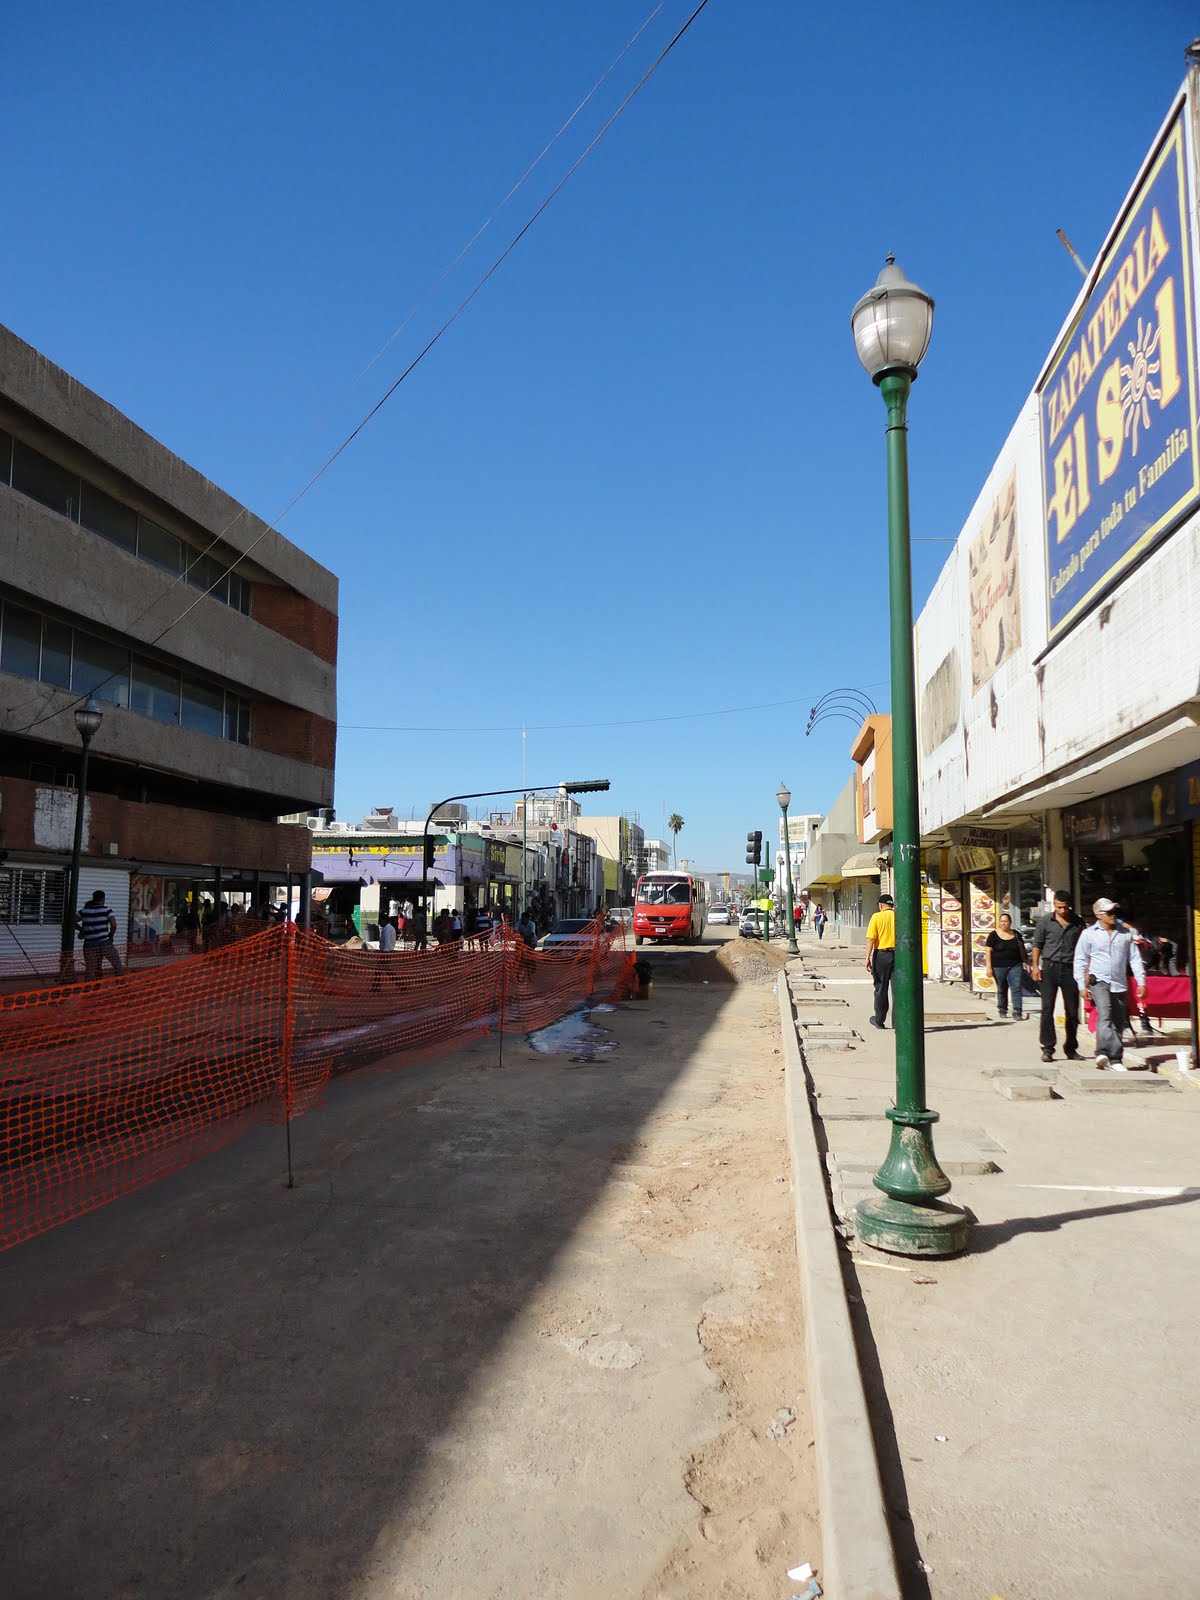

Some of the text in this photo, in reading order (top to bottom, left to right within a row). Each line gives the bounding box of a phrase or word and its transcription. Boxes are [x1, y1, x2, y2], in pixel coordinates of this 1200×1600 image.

[1048, 206, 1169, 449] ZAPATERIA
[1047, 413, 1091, 544] El
[1050, 427, 1189, 599] Calzado para toda tu Familia
